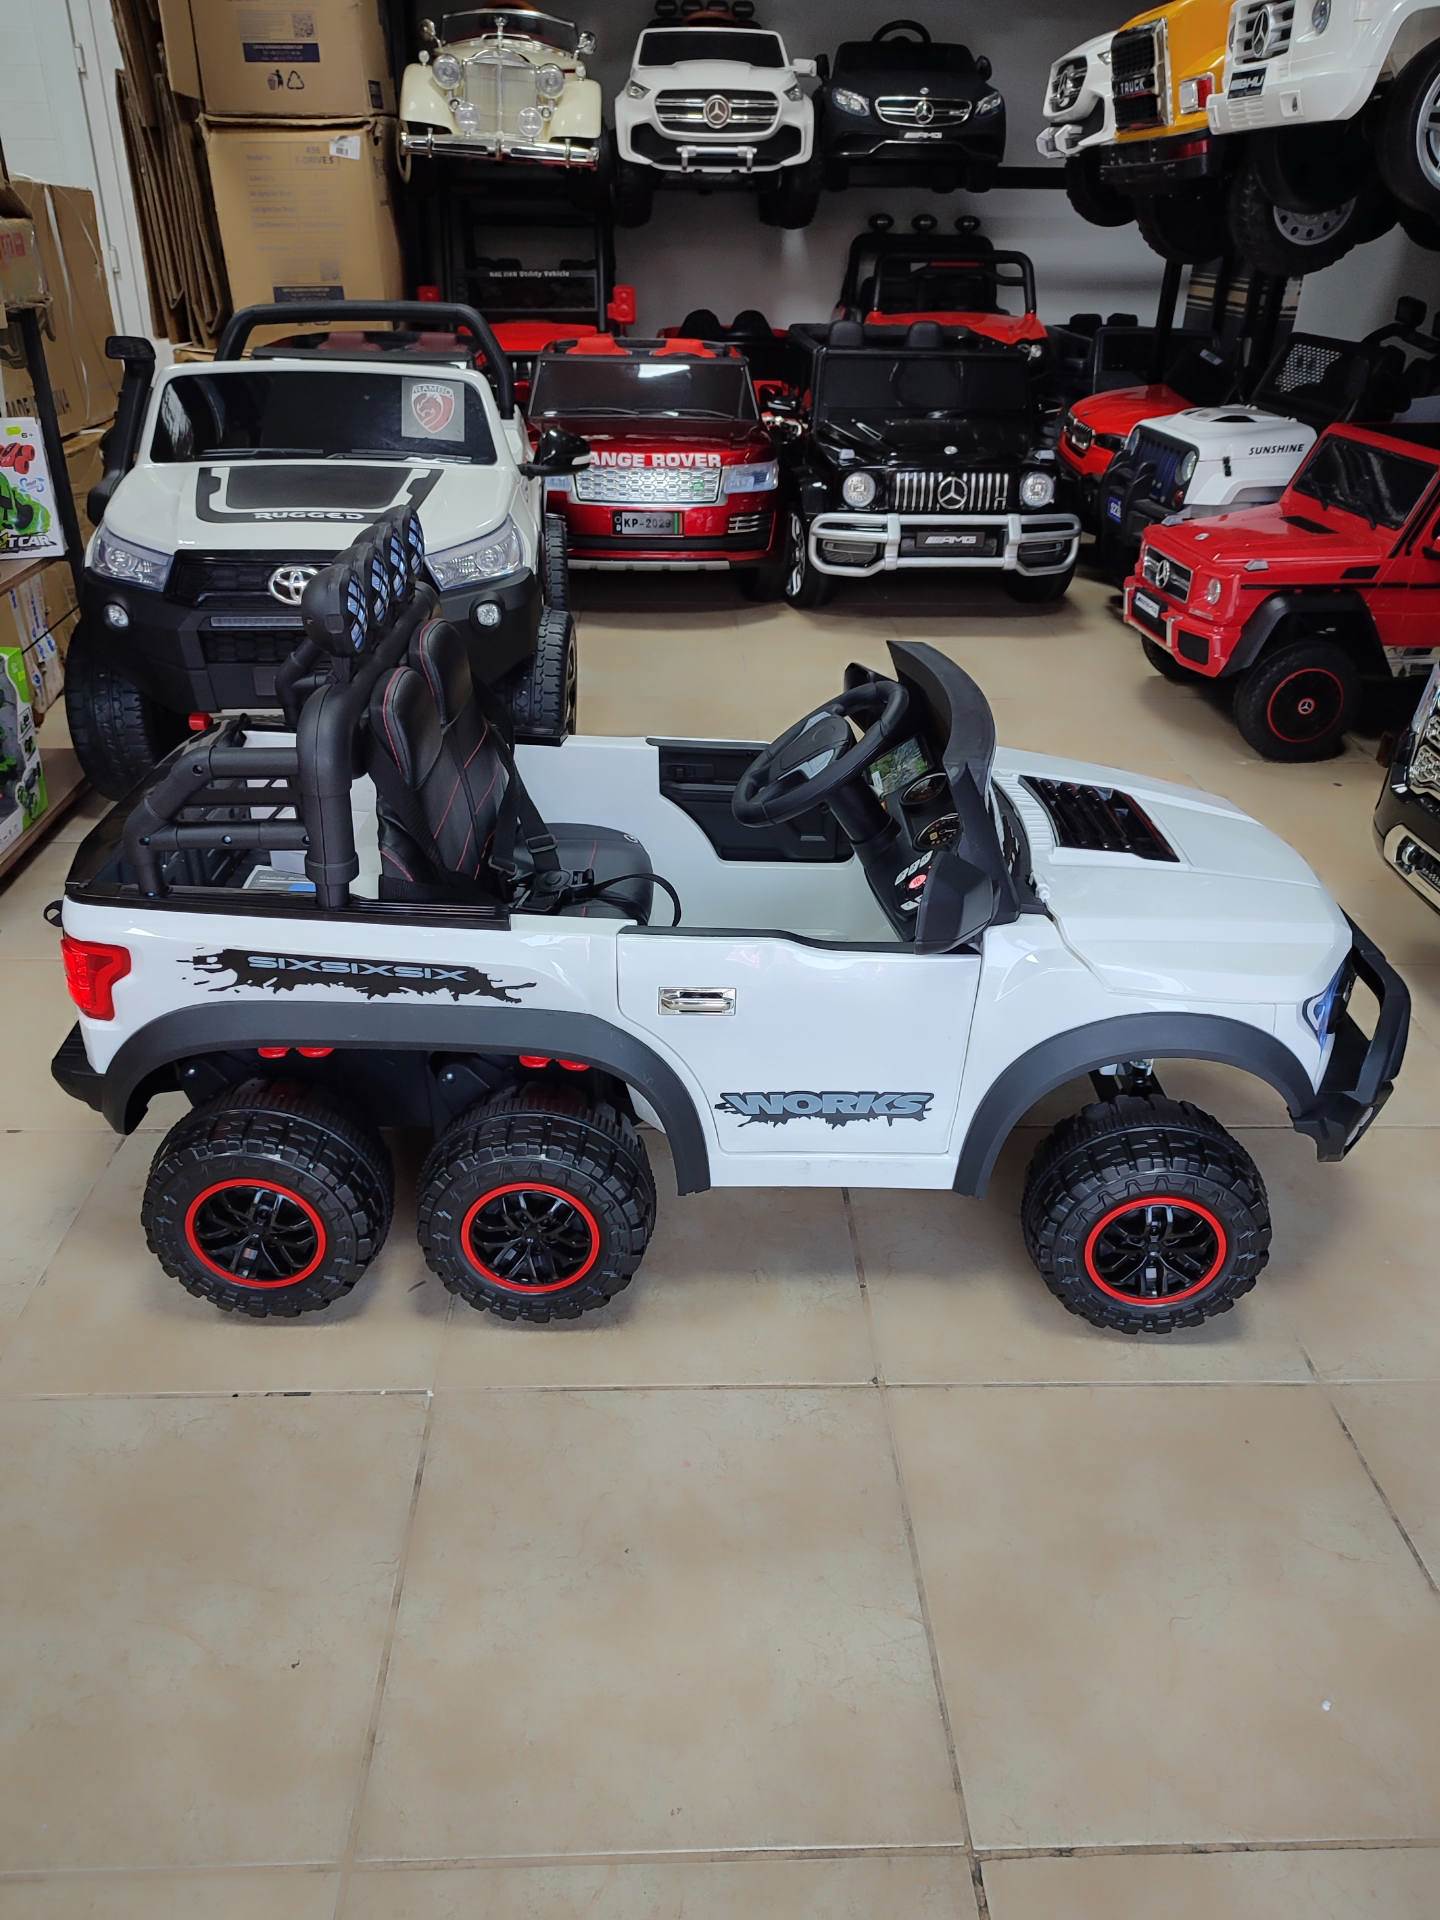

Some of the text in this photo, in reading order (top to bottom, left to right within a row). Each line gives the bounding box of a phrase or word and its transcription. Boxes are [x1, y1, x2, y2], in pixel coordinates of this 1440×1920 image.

[1120, 82, 1145, 94] TRUCK
[543, 270, 570, 278] Vehicle
[1249, 444, 1305, 456] SUNSHINE
[590, 452, 721, 468] ANGE ROVER
[254, 511, 364, 520] RUGGED
[930, 536, 976, 544] AMG
[247, 956, 468, 982] SIXSIXSIX
[722, 1093, 931, 1115] WORKS
